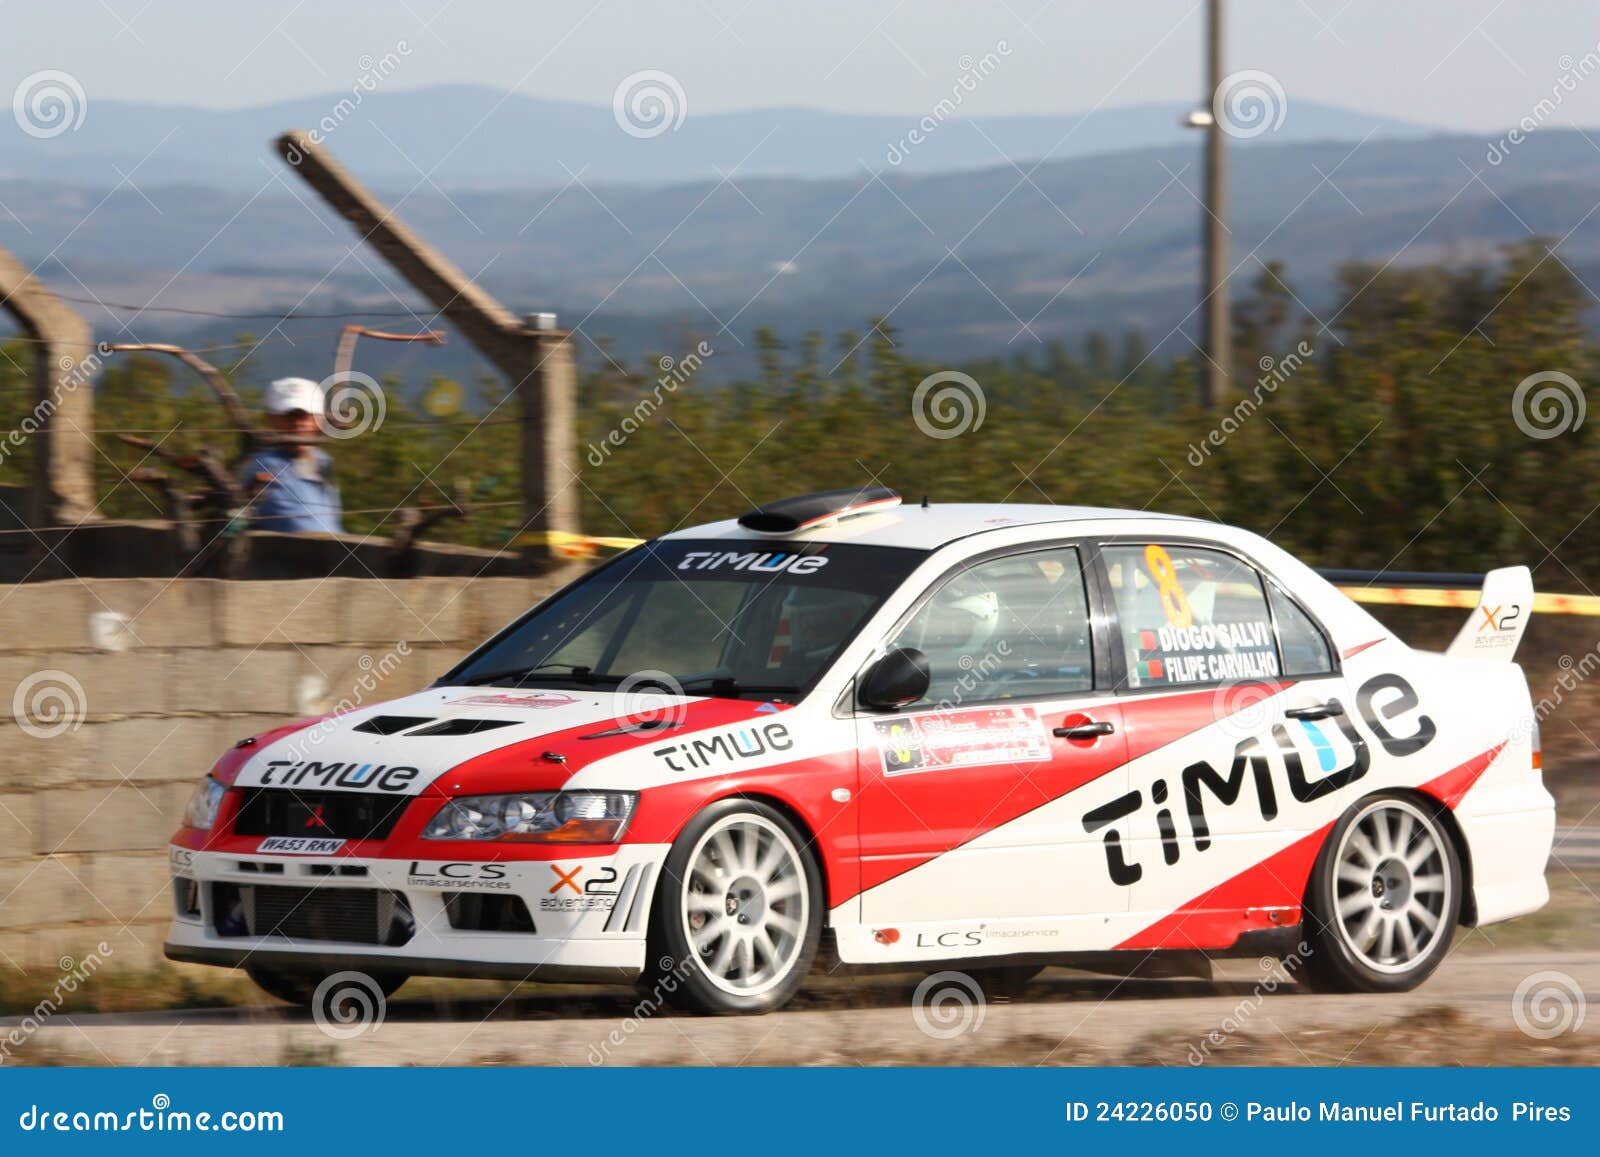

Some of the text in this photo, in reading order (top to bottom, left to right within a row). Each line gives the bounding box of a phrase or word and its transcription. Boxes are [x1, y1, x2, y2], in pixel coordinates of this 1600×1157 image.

[1144, 544, 1193, 629] 8
[1478, 604, 1520, 631] X2
[1158, 621, 1270, 653] DIOGO SALVI
[1164, 651, 1279, 682] FILIPE CARVALHO
[262, 838, 341, 852] WA53 RKN
[409, 861, 506, 879] LCS
[548, 864, 617, 895] X2
[916, 931, 982, 947] LCS
